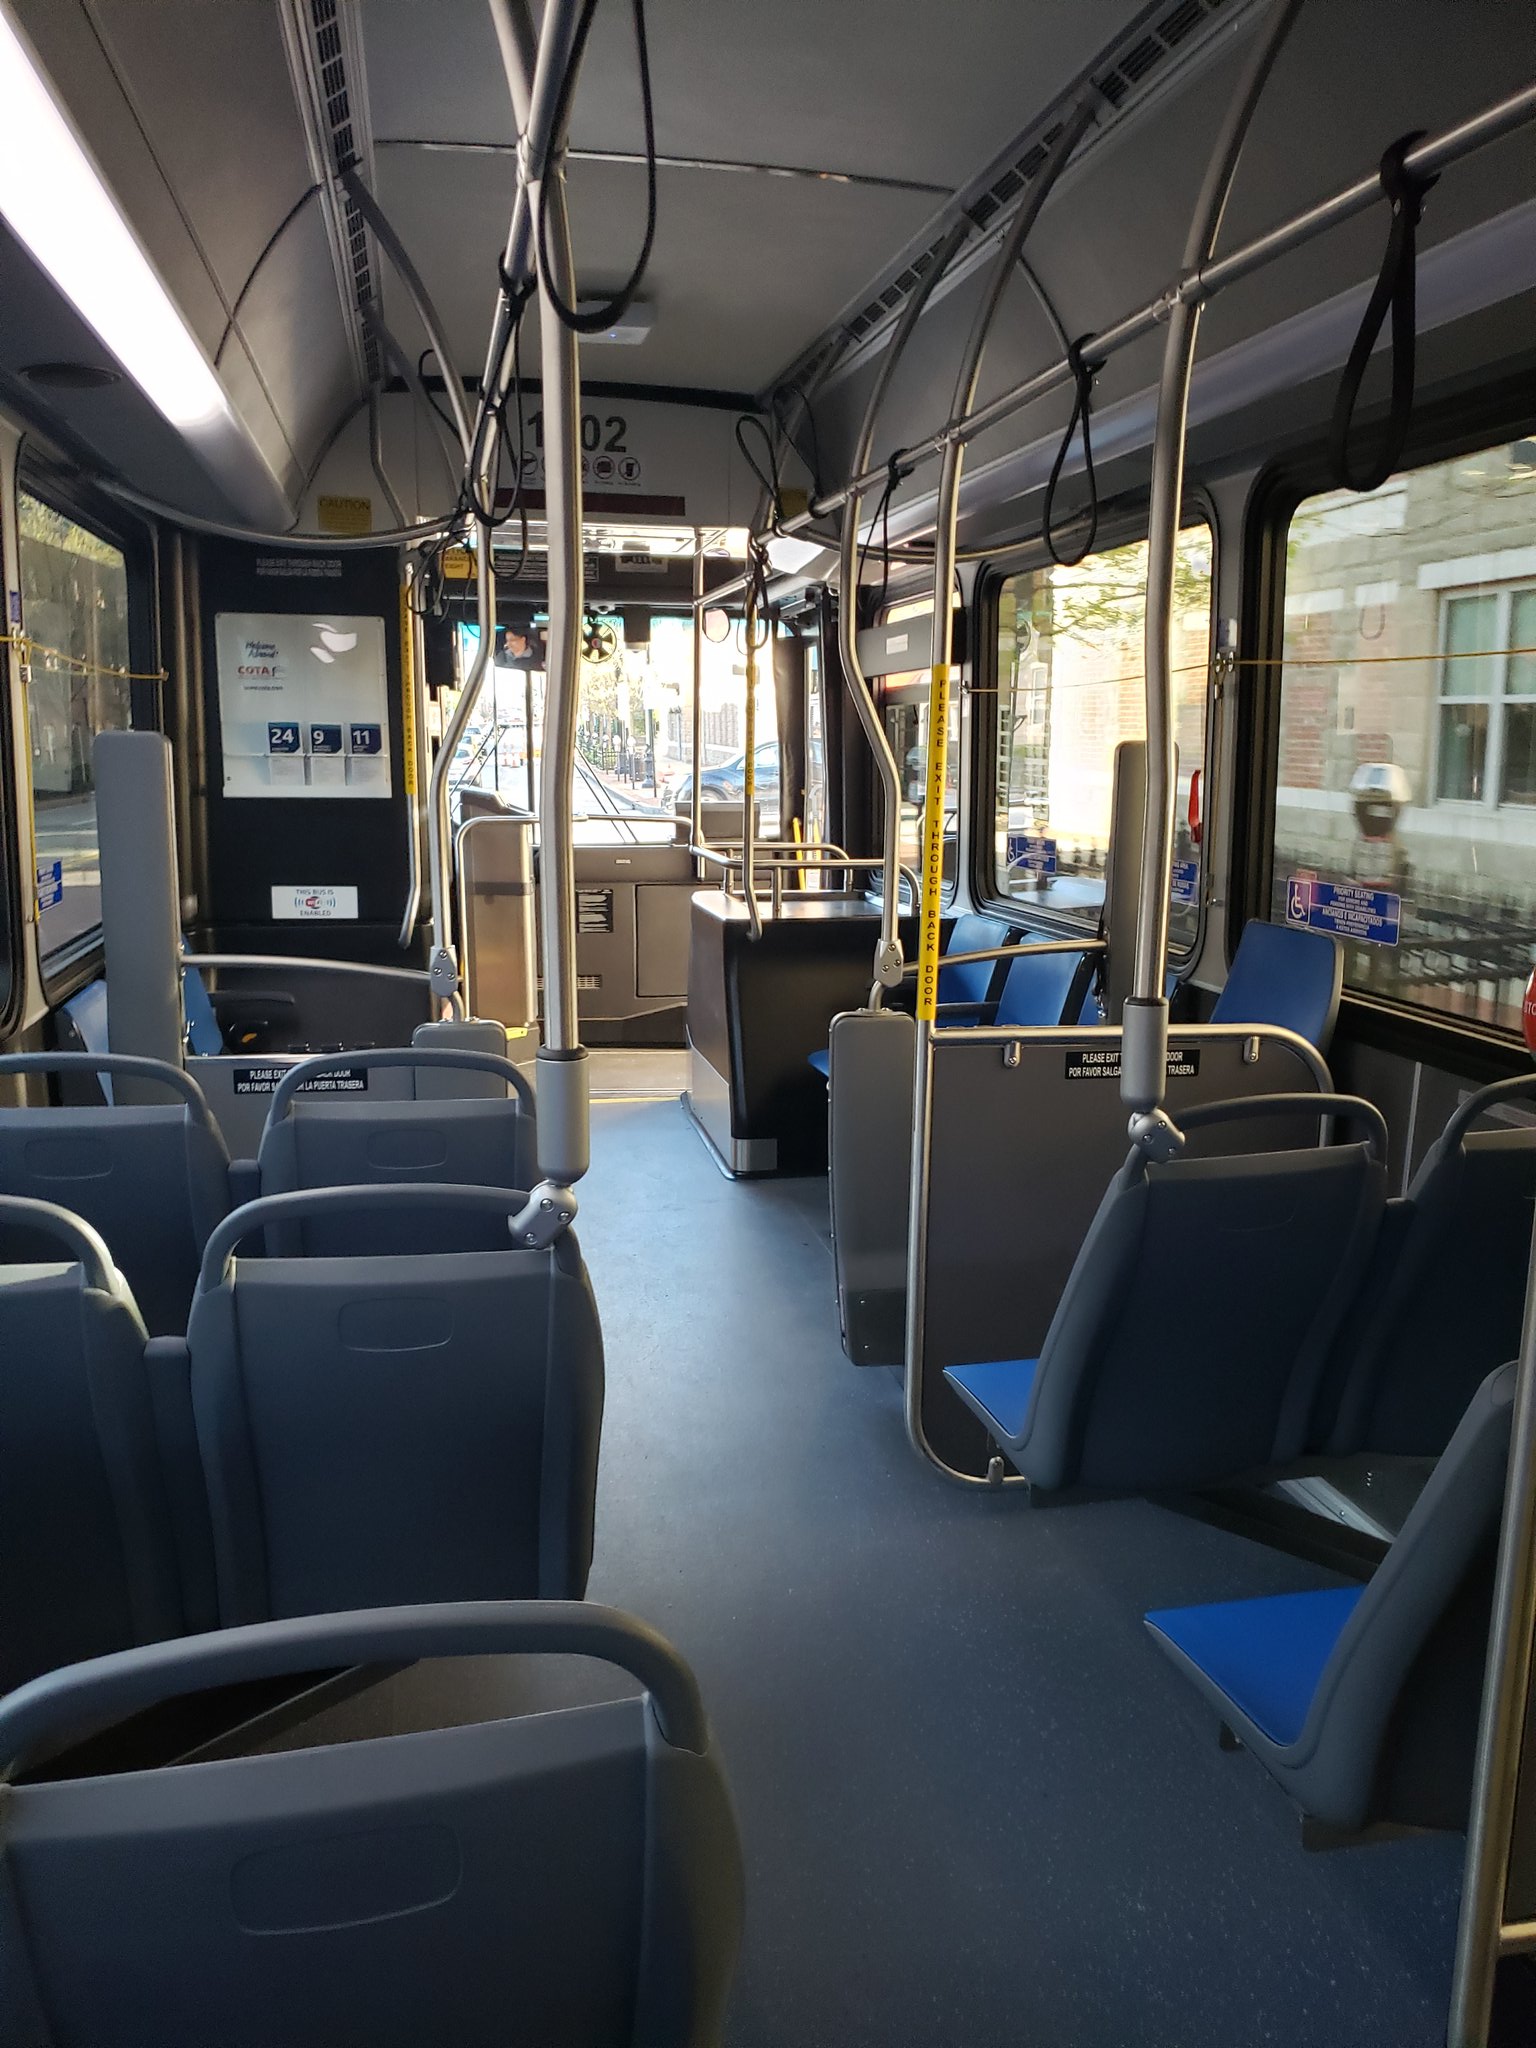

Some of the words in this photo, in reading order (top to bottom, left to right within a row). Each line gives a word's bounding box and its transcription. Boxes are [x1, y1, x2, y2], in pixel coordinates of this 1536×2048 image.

[527, 412, 626, 452] 102
[238, 666, 270, 675] COTA
[936, 680, 946, 747] PLEASE
[271, 728, 294, 744] 24
[313, 730, 324, 745] 9
[353, 730, 370, 745] 11
[934, 763, 942, 805] EXIT
[929, 821, 940, 896] THROUGH
[926, 911, 936, 952] BACK
[924, 965, 934, 1005] DOOR
[1082, 1053, 1105, 1064] PLEASE
[1106, 1053, 1119, 1063] EXIT
[1166, 1051, 1183, 1062] DOOR
[250, 1070, 273, 1080] PLEASE
[274, 1069, 287, 1079] EXIT
[1069, 1067, 1081, 1077] POR
[1082, 1067, 1101, 1077] FAVOR
[1102, 1066, 1121, 1076] SALGA
[1168, 1065, 1194, 1075] TRASERA
[237, 1083, 250, 1092] POR
[251, 1082, 270, 1092] FAVOR
[305, 1081, 313, 1090] LA
[314, 1080, 336, 1090] PUERTA
[337, 1080, 364, 1089] TRASERA
